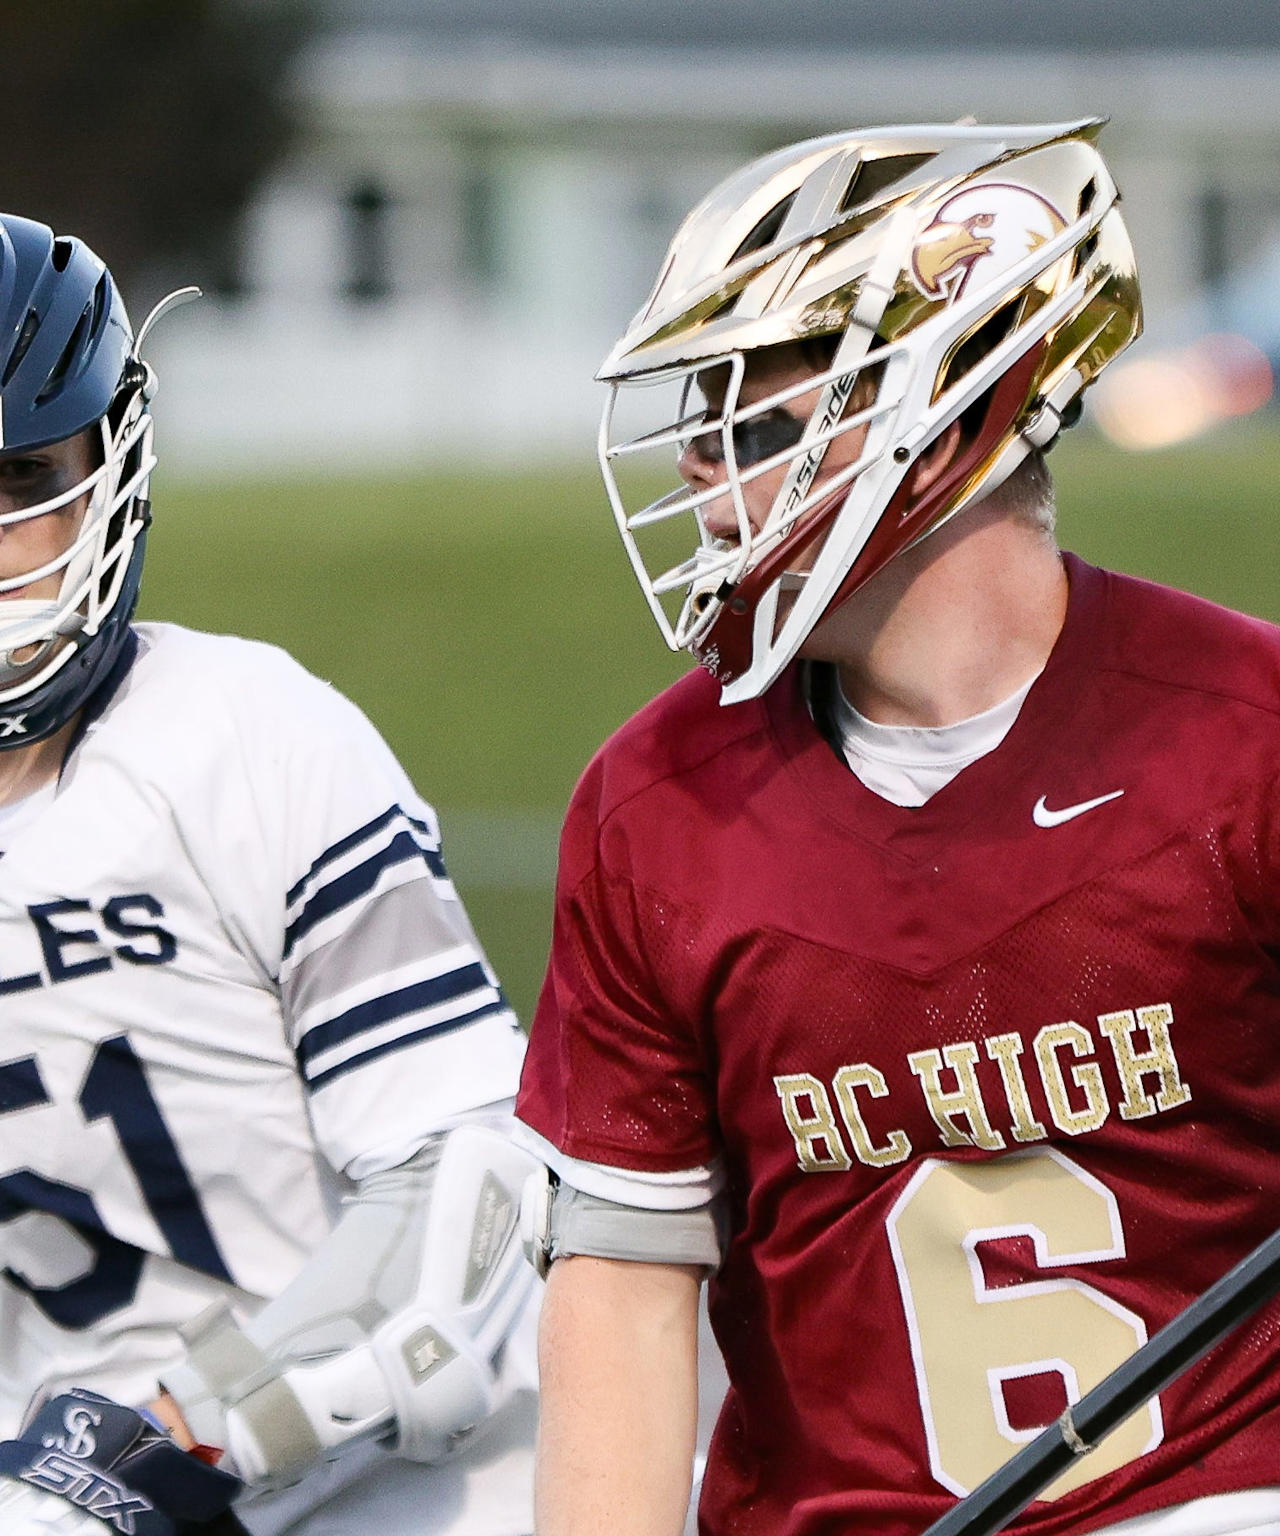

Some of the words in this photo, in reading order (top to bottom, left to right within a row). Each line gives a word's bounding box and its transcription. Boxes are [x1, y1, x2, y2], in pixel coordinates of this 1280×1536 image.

[773, 1063, 912, 1173] BC
[907, 1002, 1193, 1151] HIGH
[885, 1144, 1164, 1503] 6
[19, 1453, 154, 1536] STX
